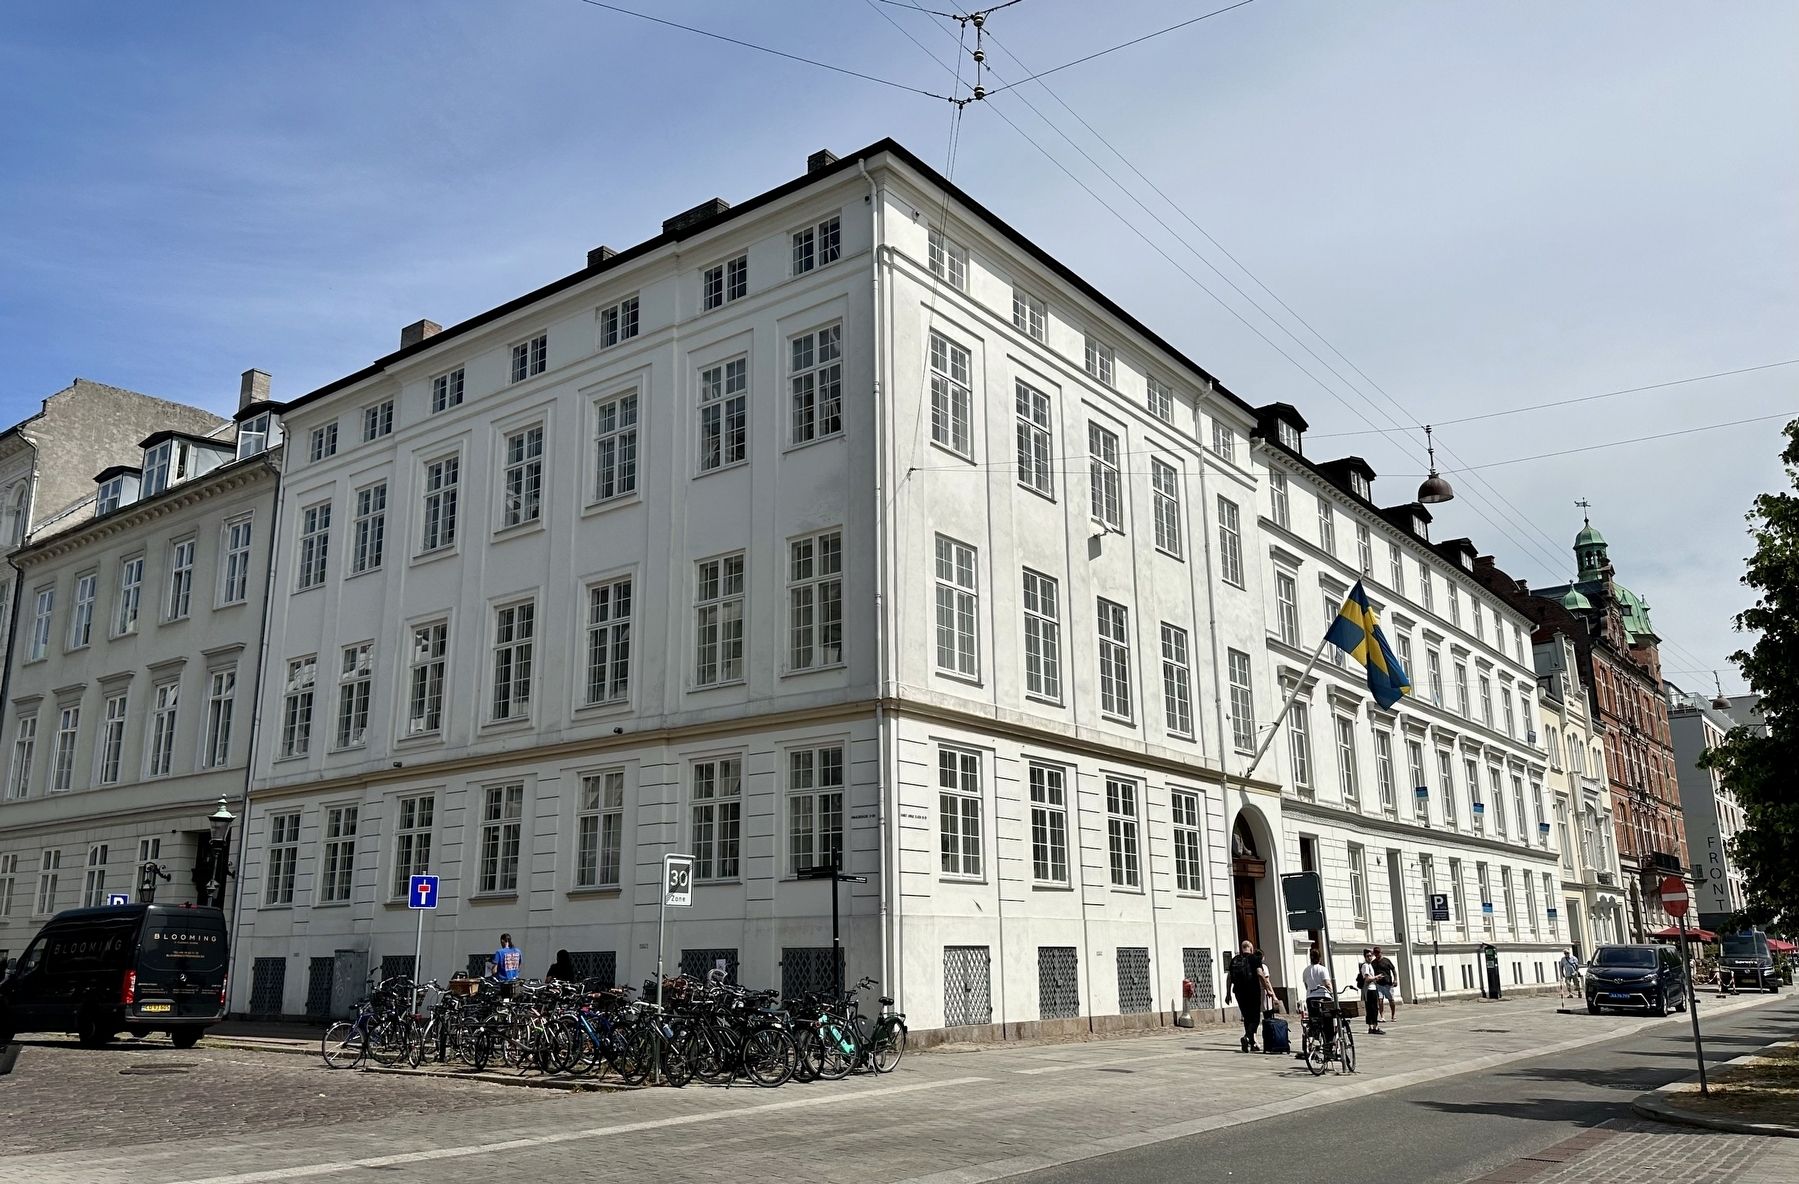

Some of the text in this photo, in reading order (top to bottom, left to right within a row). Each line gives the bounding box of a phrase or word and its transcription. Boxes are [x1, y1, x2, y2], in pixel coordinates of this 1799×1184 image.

[670, 870, 688, 886] 30
[1707, 836, 1725, 911] FRONT
[1434, 896, 1444, 909] P
[154, 933, 217, 942] BLOOMING
[54, 939, 122, 955] BLOOMING
